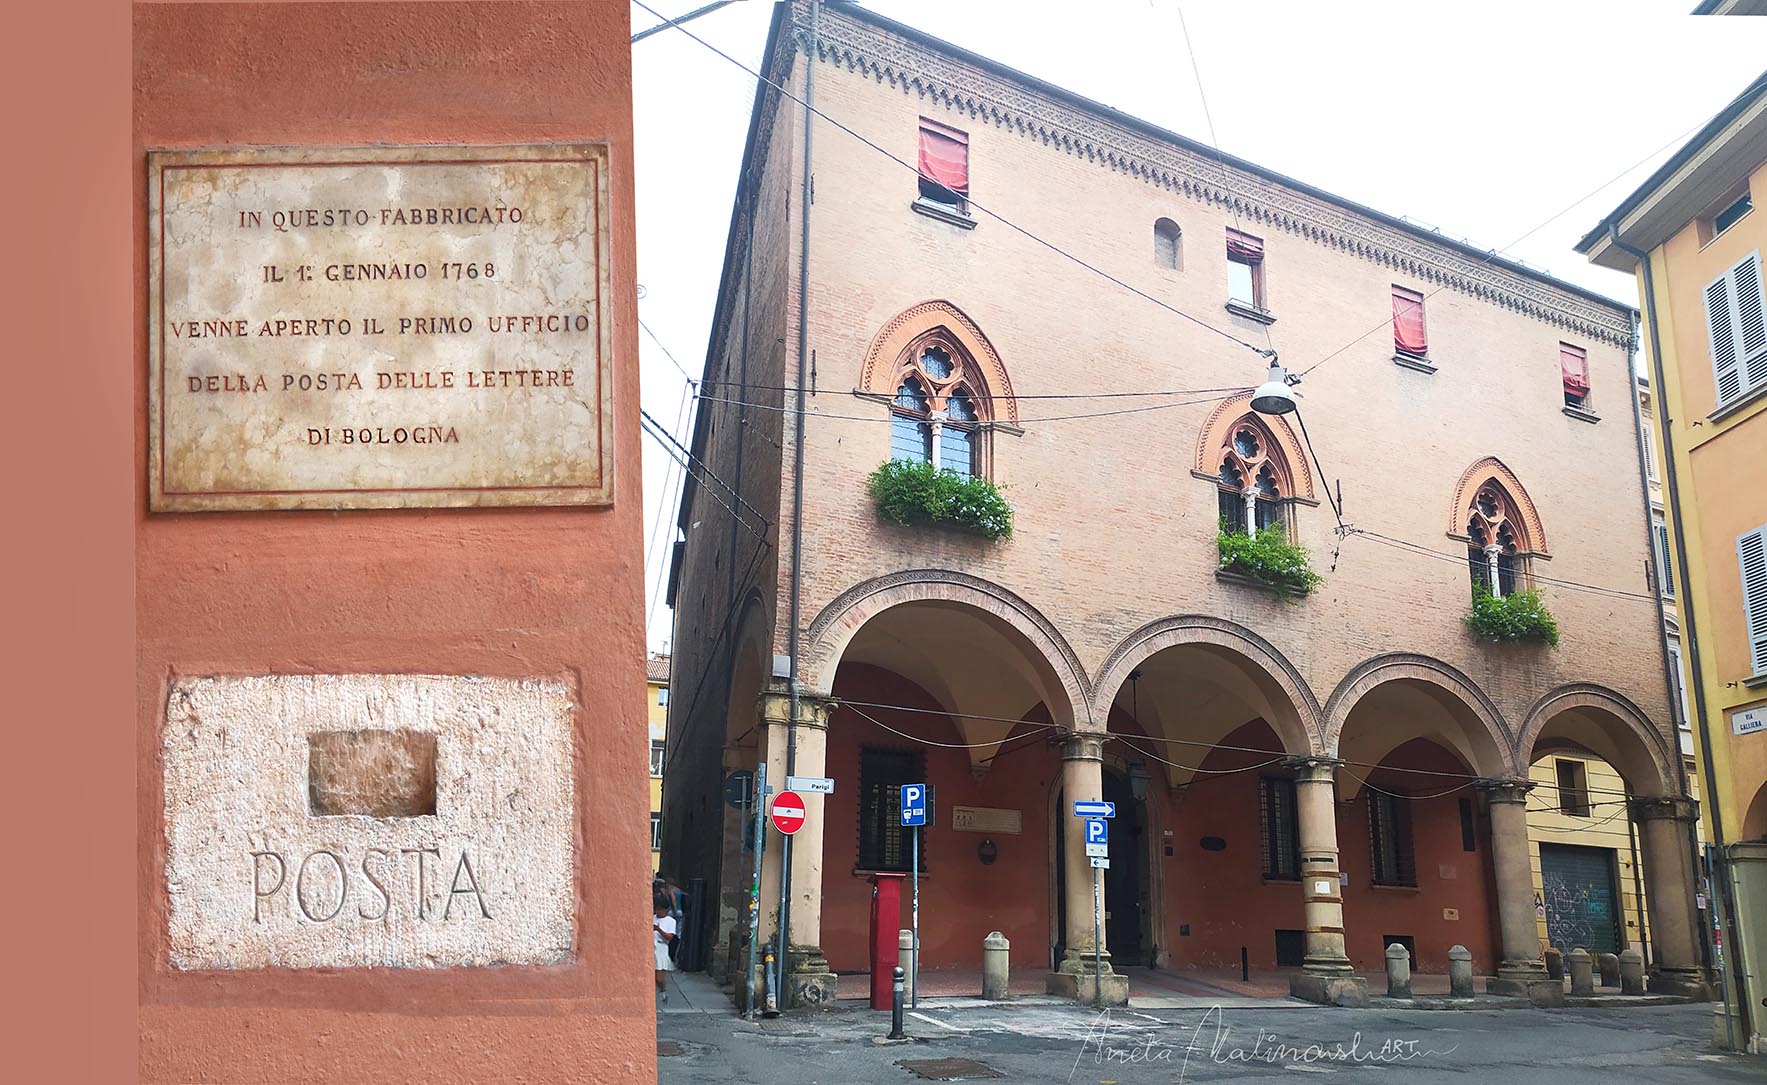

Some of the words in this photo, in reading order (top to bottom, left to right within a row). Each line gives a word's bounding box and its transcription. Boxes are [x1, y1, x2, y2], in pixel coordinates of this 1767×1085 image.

[238, 210, 262, 228] IN
[272, 209, 369, 233] QUESTO
[379, 206, 523, 226] FABBRICATO
[263, 265, 284, 283] IL
[325, 262, 428, 282] GENNAIO
[440, 262, 496, 280] 1768
[170, 319, 249, 338] VENNE
[258, 318, 352, 337] APERTO
[362, 318, 385, 335] IL
[399, 316, 473, 335] PRIMO
[488, 314, 589, 333] UFFICIO
[187, 373, 268, 393] DELLA
[281, 372, 363, 391] POSTA
[376, 371, 454, 390] DELLE
[467, 368, 575, 388] LETTERE
[307, 428, 330, 445] DI
[341, 426, 460, 445] BOLOGNA
[811, 783, 830, 791] Parigi
[907, 787, 920, 807] P
[1089, 821, 1104, 842] P
[249, 849, 495, 925] POSTA
